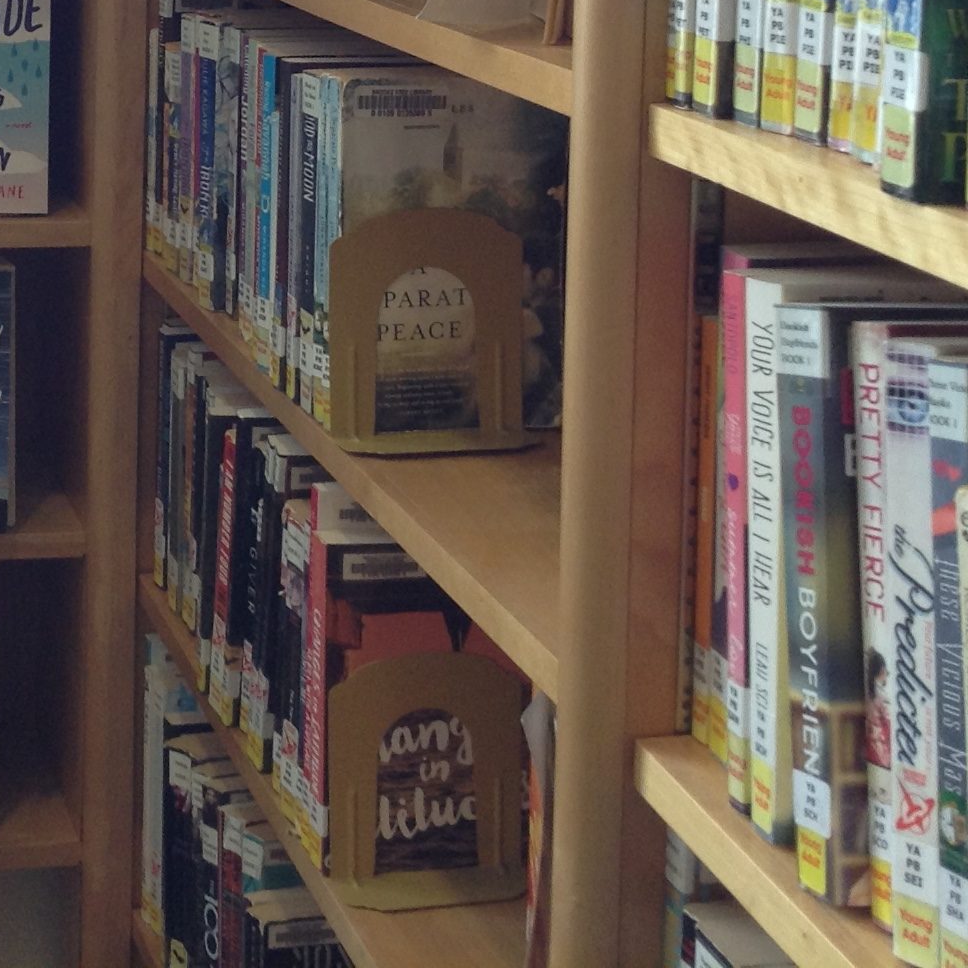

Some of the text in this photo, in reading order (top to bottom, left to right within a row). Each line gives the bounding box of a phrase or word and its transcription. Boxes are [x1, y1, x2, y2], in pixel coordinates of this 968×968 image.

[239, 96, 251, 162] Jordan
[260, 114, 273, 182] Savannah
[302, 152, 315, 203] MOON
[383, 287, 469, 309] PARAT
[377, 320, 463, 343] PEACE
[749, 319, 772, 383] YOUR
[750, 387, 775, 455] VOICE
[752, 459, 775, 482] IS
[856, 362, 886, 625] PRETTY FIERCE
[753, 486, 774, 525] ALL
[891, 522, 907, 559] the
[248, 546, 259, 614] GIVER
[751, 550, 774, 607] HEAR
[791, 405, 822, 775] BOOKISH BOYFRIEN
[753, 641, 770, 682] LEAH
[935, 557, 965, 728] These Vicious
[419, 755, 450, 783] in
[905, 842, 922, 858] YA
